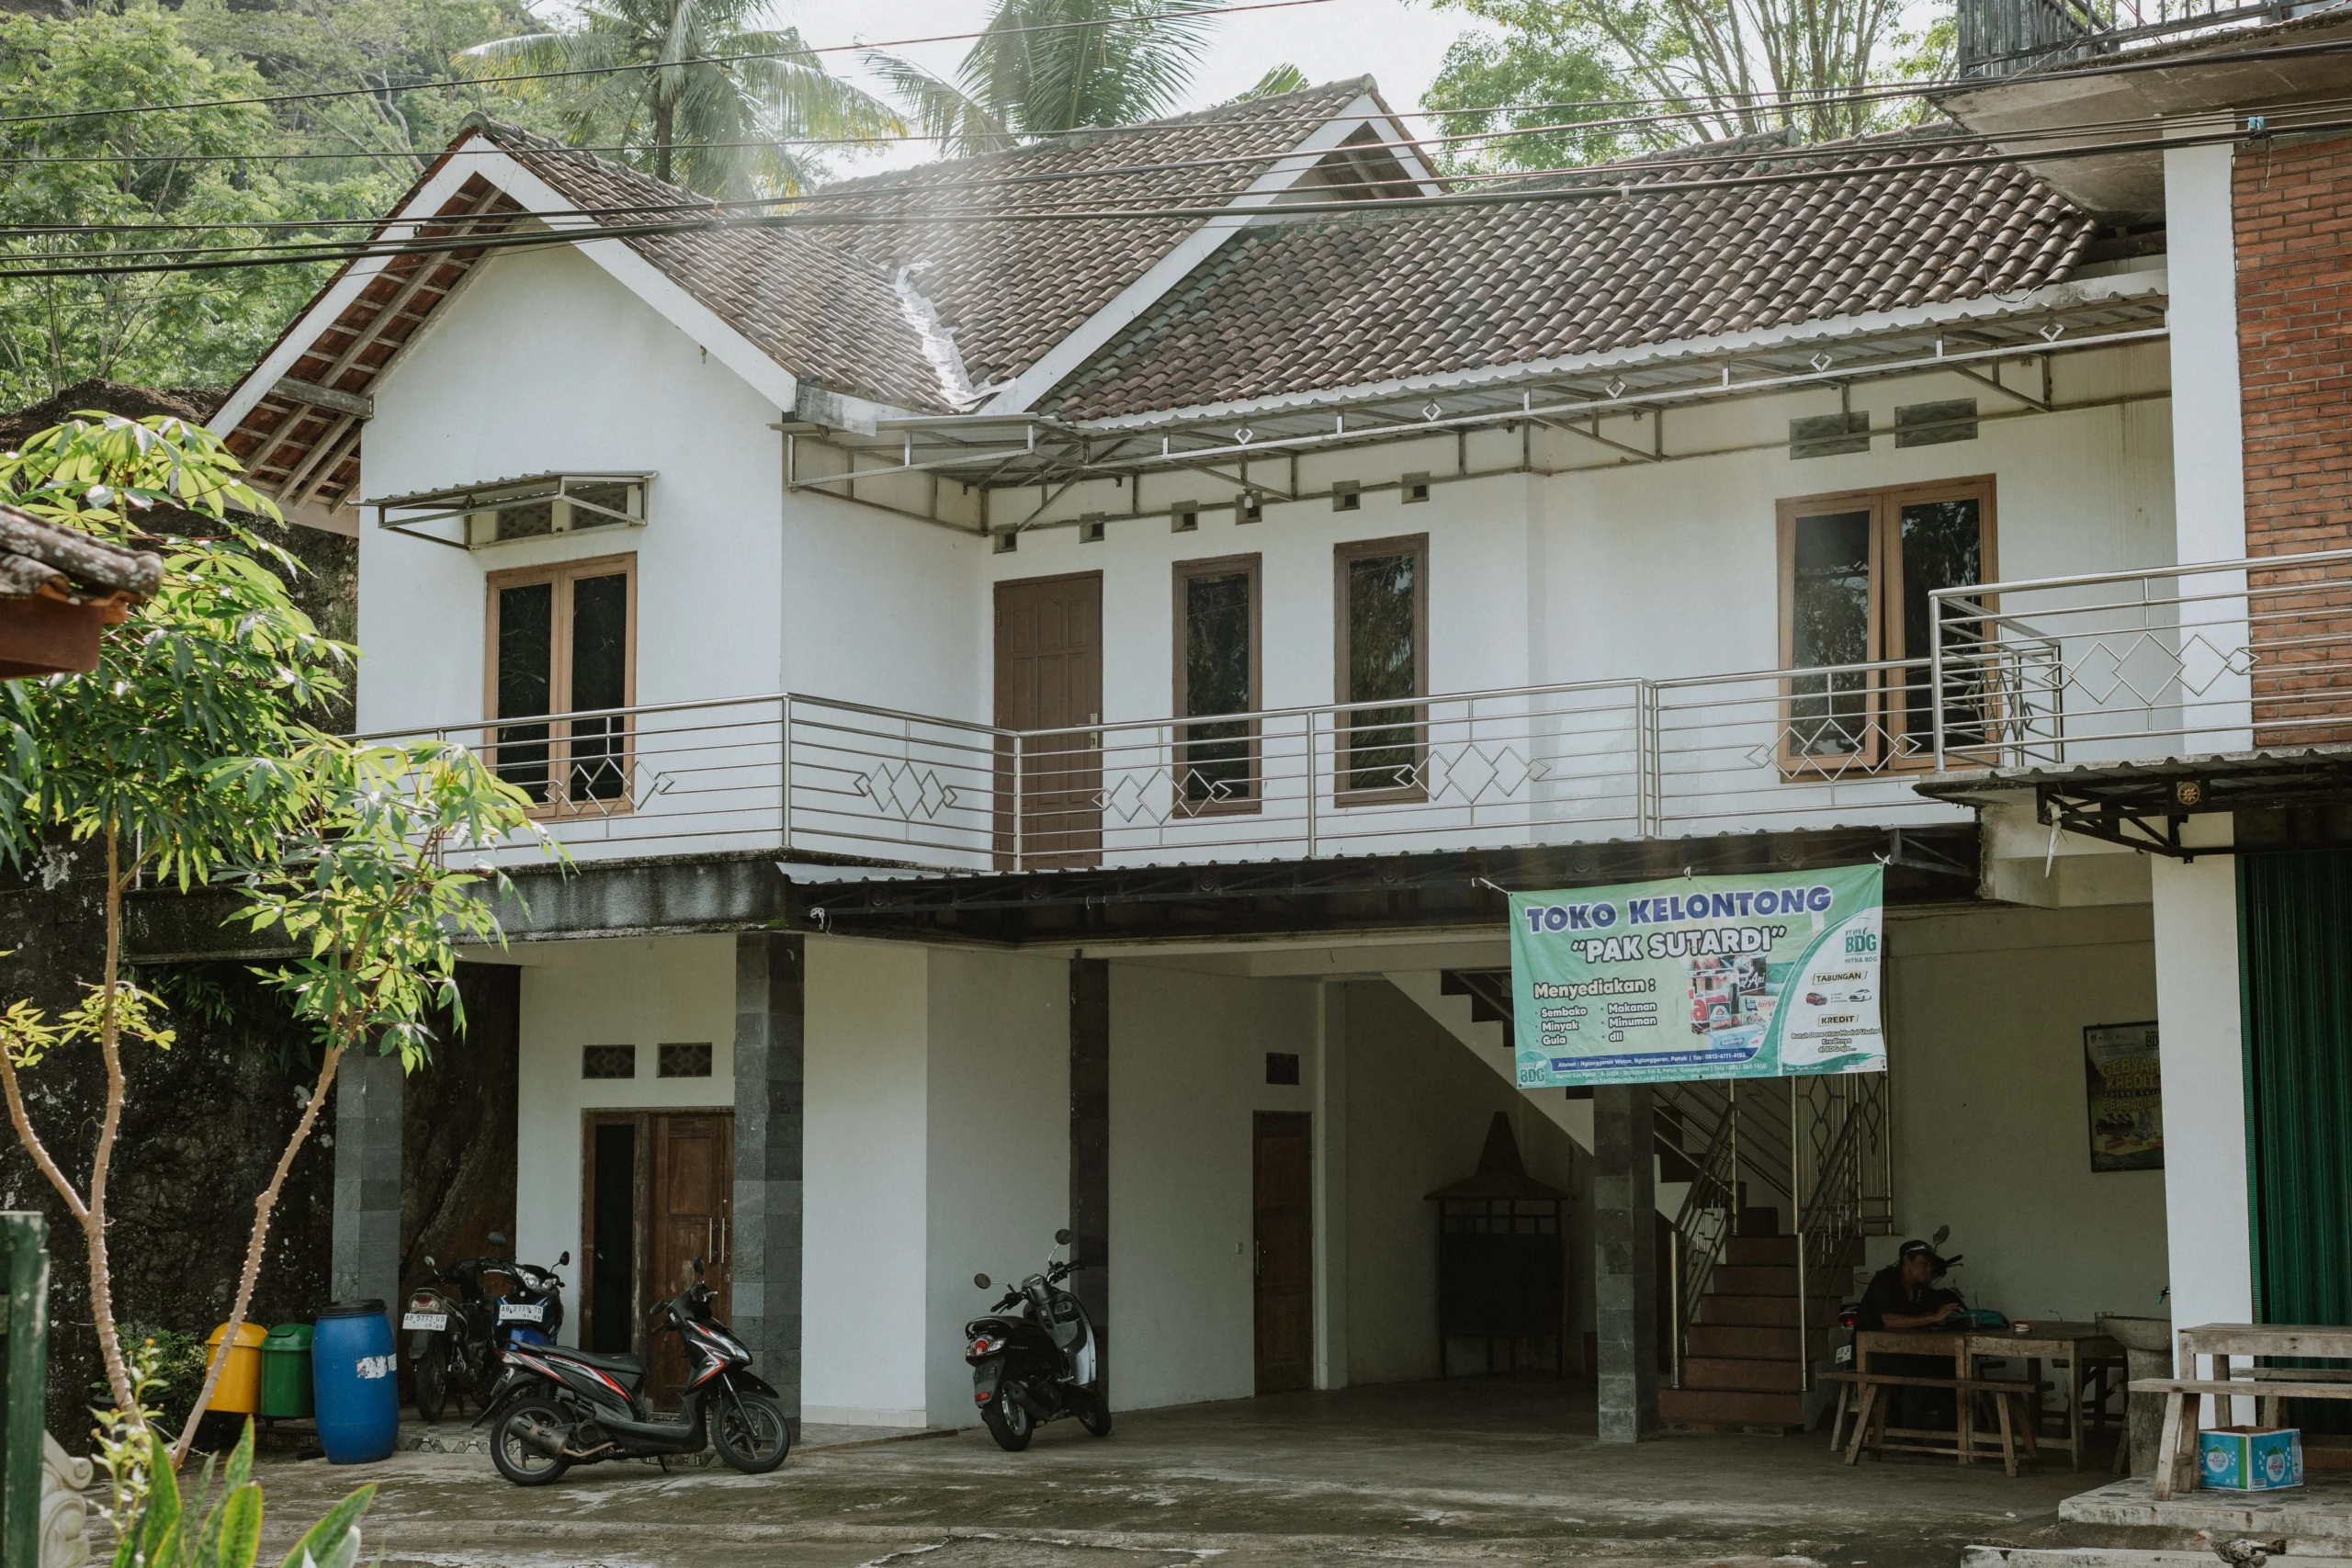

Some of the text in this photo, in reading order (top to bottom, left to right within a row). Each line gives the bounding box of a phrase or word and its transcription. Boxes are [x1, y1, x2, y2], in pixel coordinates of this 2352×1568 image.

[1526, 886, 1831, 932] TOKO KELONTONG
[1845, 934, 1876, 953] BDG
[1816, 973, 1860, 982] TABUNGAN
[1533, 977, 1645, 999] Menyediakan
[1542, 1007, 1588, 1018] Sembako
[1608, 1002, 1657, 1014] Makanan
[1609, 1016, 1657, 1028] Minuman
[1821, 1016, 1854, 1024] KREDIT
[1542, 1021, 1578, 1032] Minyak
[1542, 1035, 1566, 1045] Gula
[1609, 1031, 1623, 1042] dll
[2101, 1056, 2160, 1077] GEBYAR
[1520, 1067, 1545, 1083] BDG
[2106, 1074, 2155, 1091] KREDIT
[2103, 1095, 2162, 1110] BERHADIAH
[712, 1350, 729, 1359] HONDA
